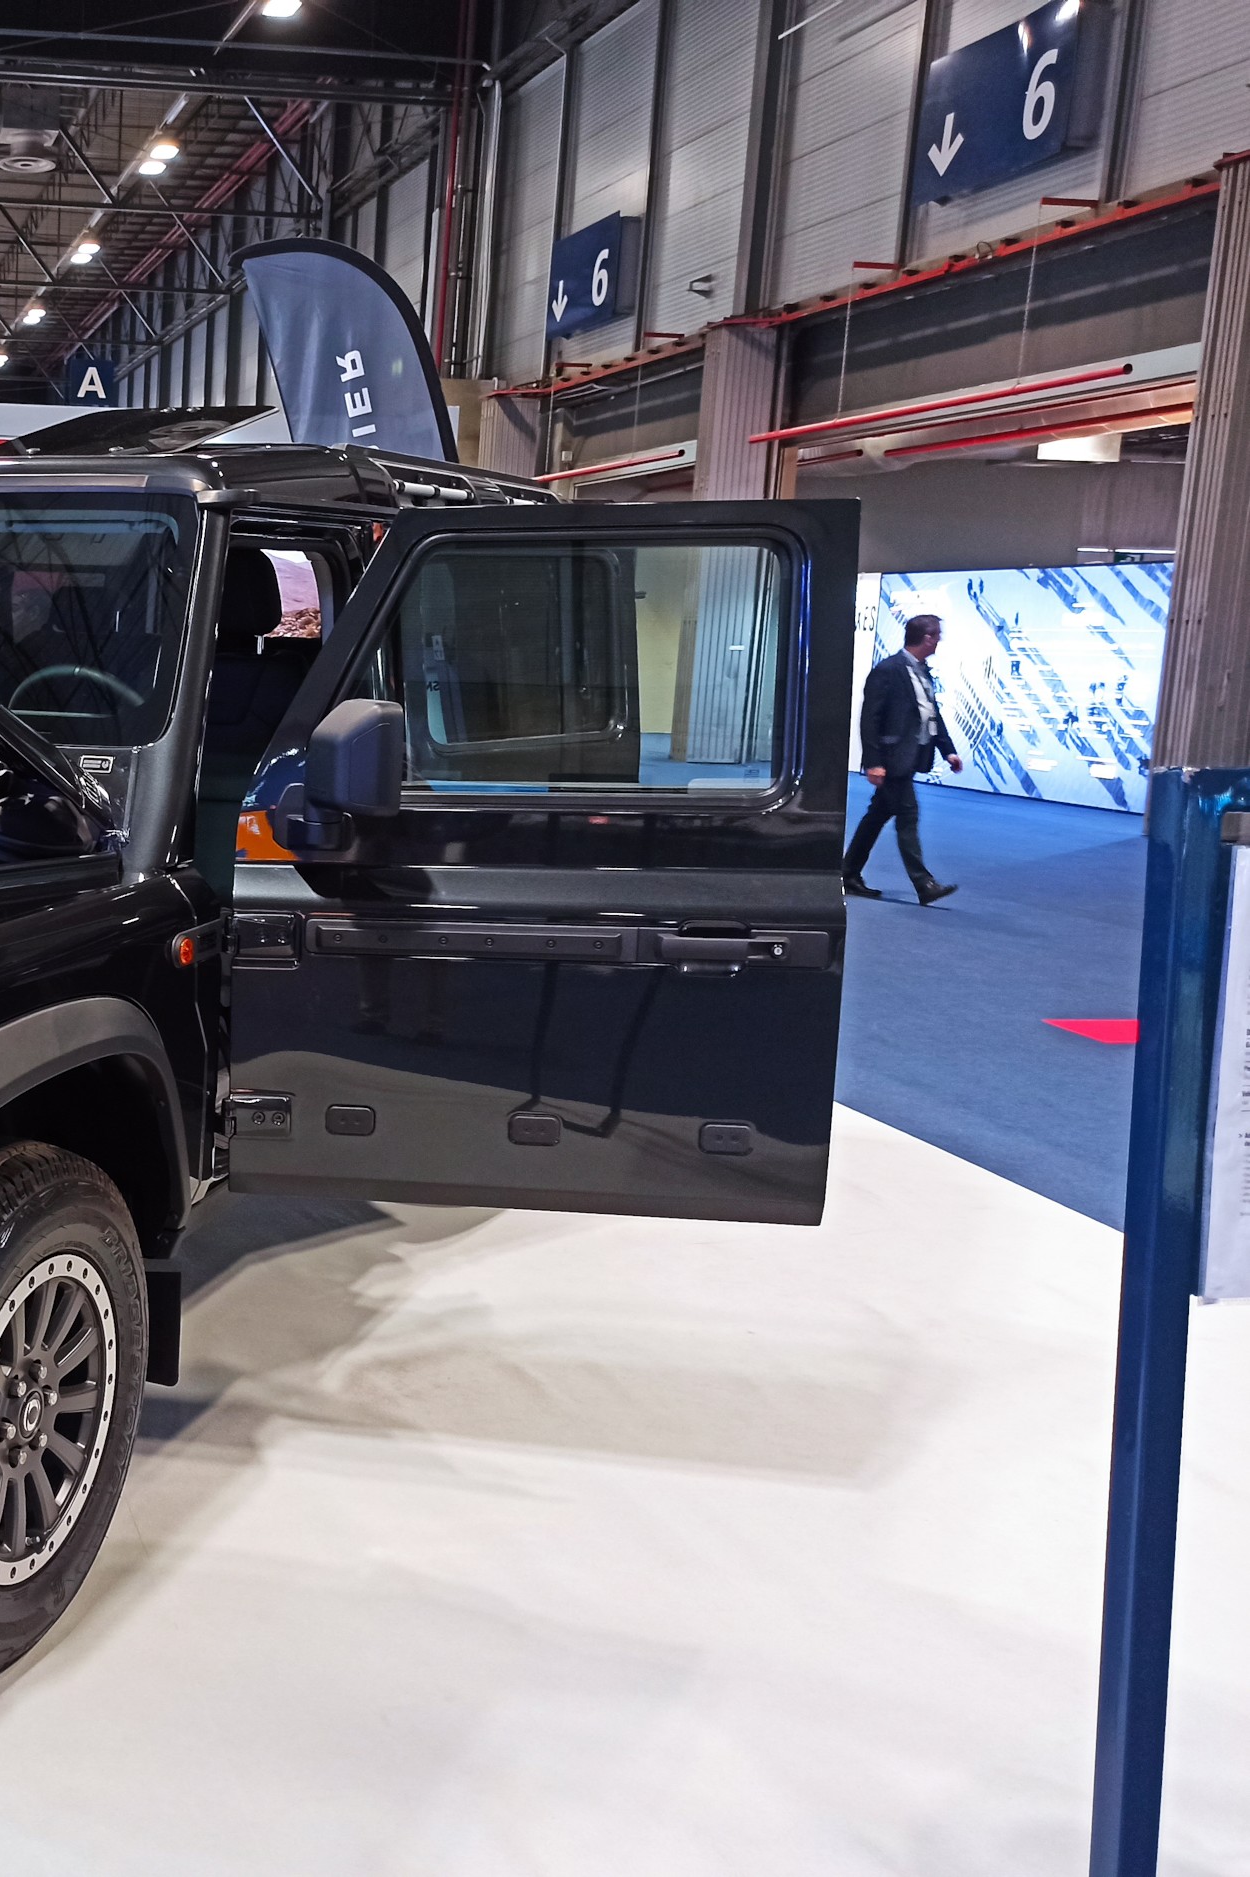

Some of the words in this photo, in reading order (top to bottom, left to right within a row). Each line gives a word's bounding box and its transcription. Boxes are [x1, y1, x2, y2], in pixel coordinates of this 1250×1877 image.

[1022, 48, 1059, 140] 6
[591, 248, 610, 307] 6
[77, 366, 106, 399] A
